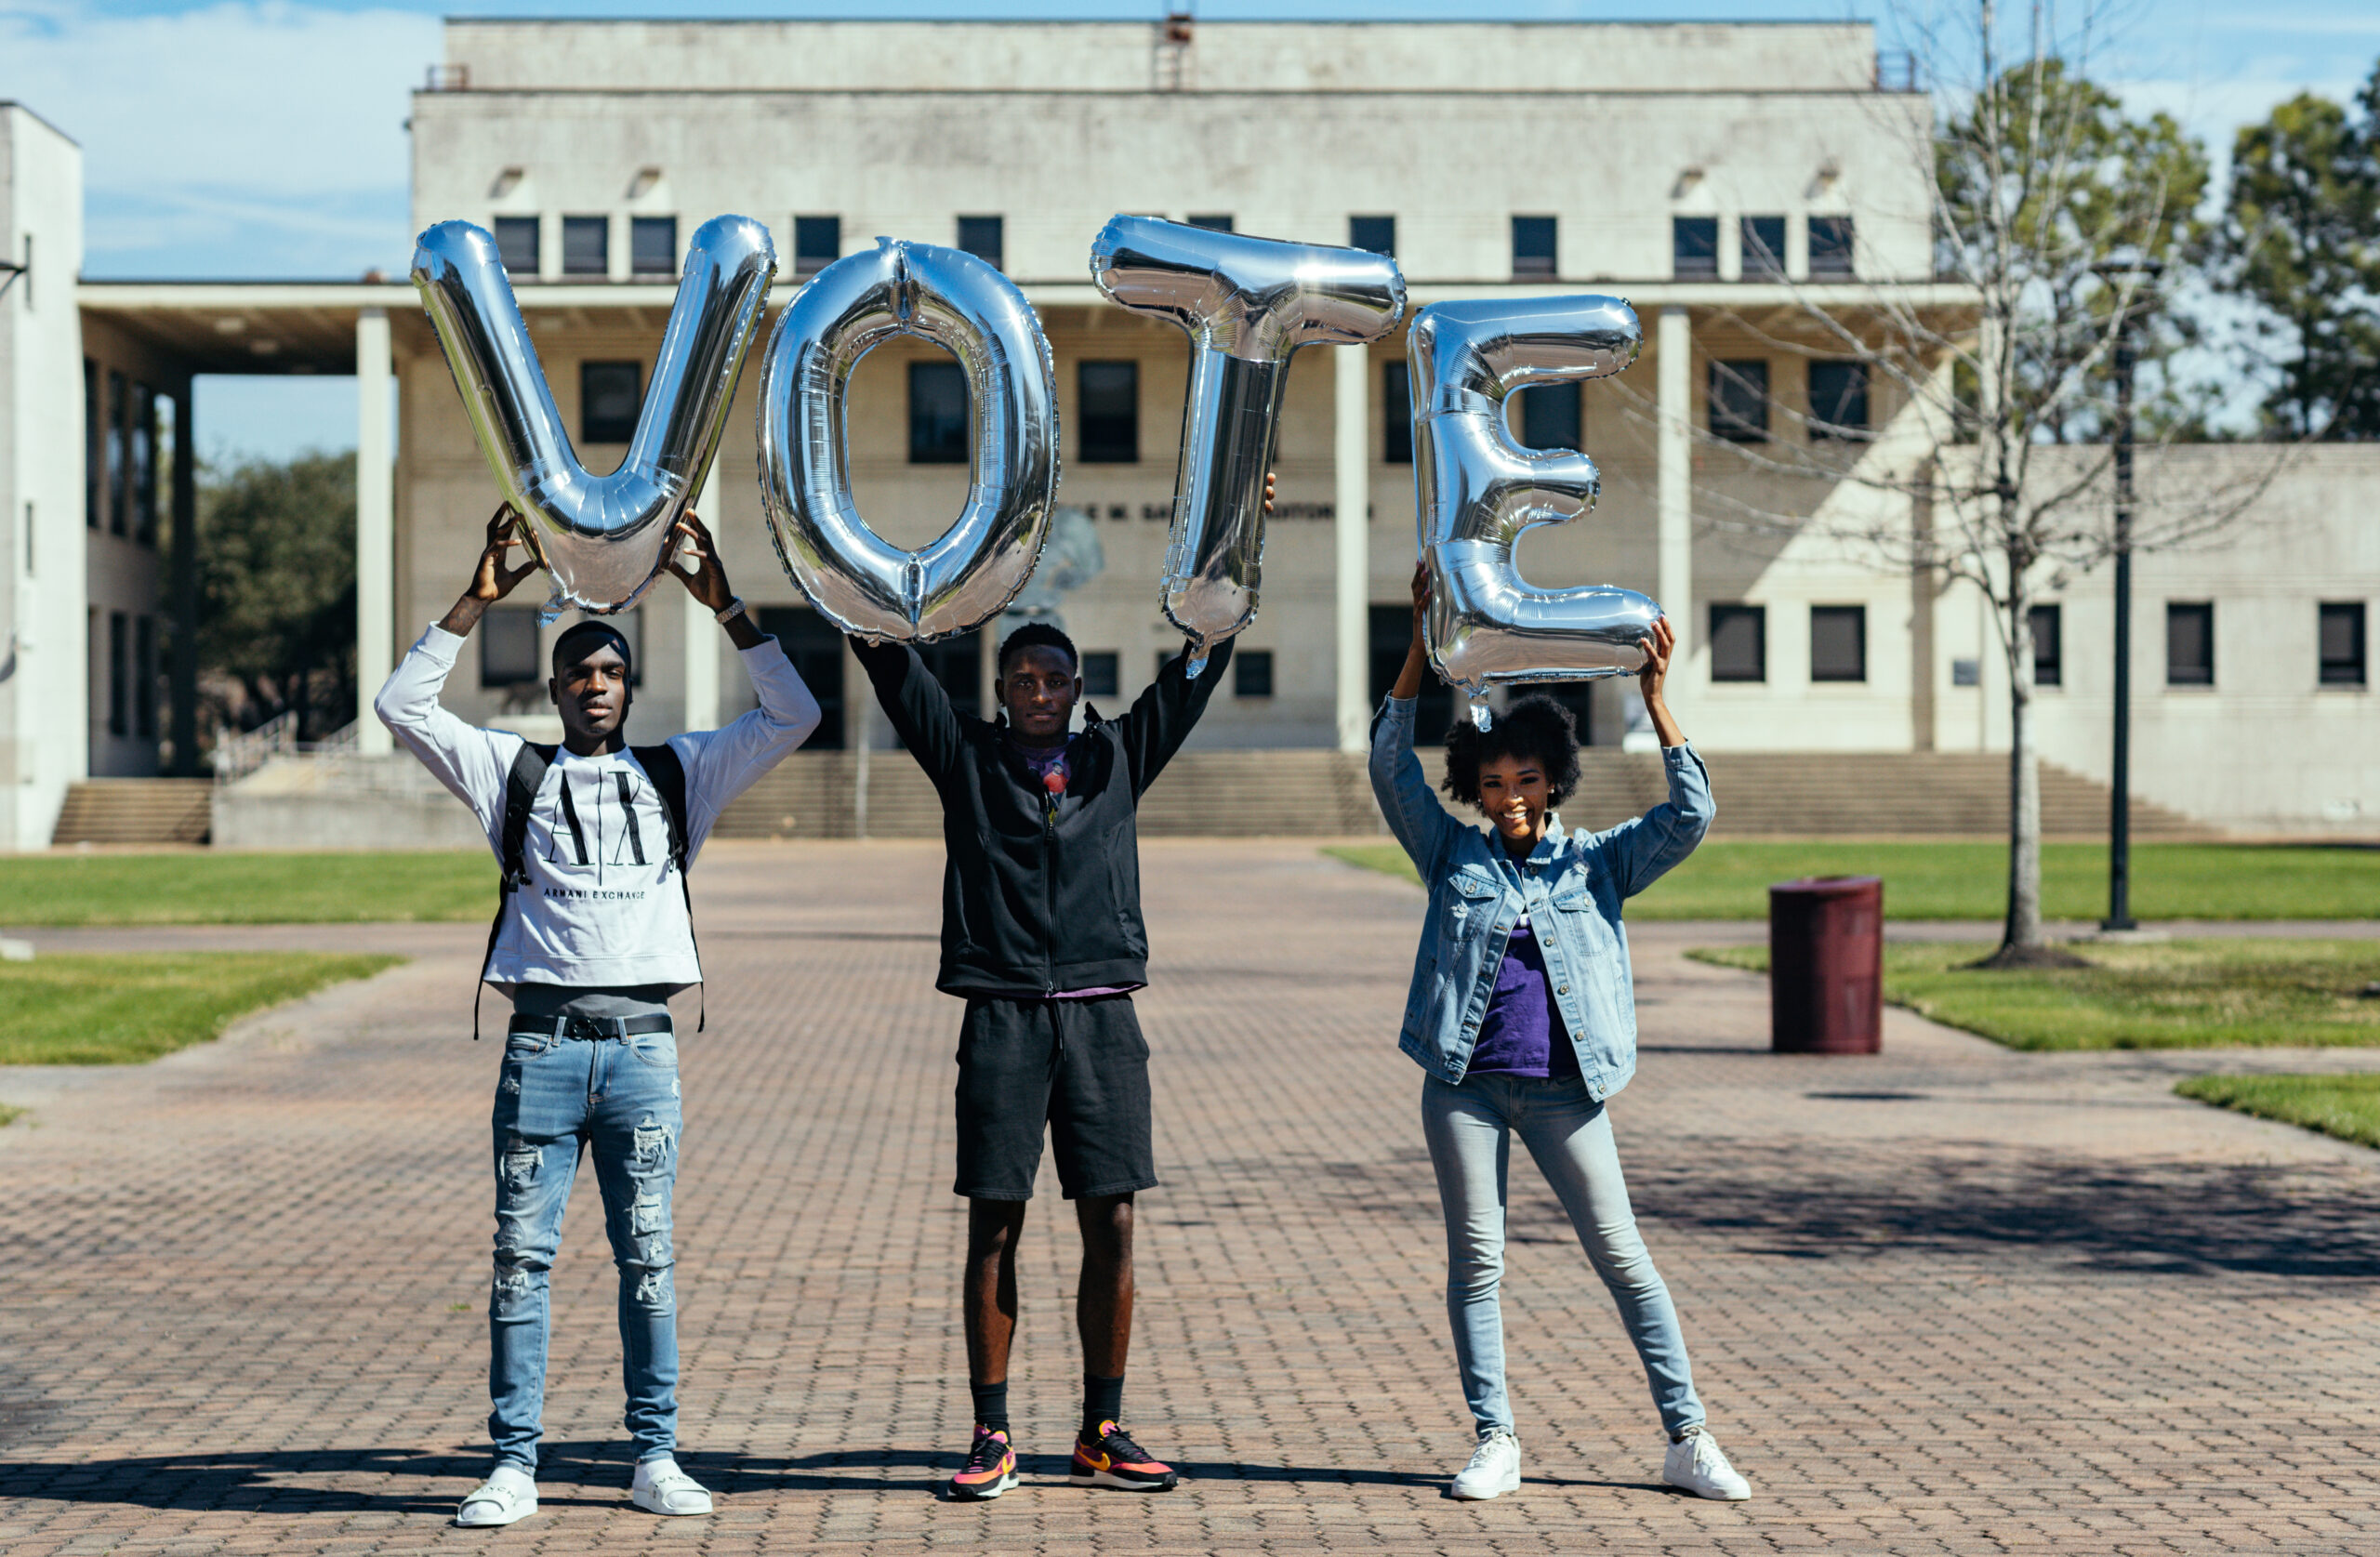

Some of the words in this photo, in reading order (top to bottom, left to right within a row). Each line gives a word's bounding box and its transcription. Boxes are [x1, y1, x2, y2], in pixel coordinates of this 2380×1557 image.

[411, 213, 1665, 690] VOTE
[544, 888, 588, 899] ARMANI
[592, 890, 645, 900] EXCHANGE
